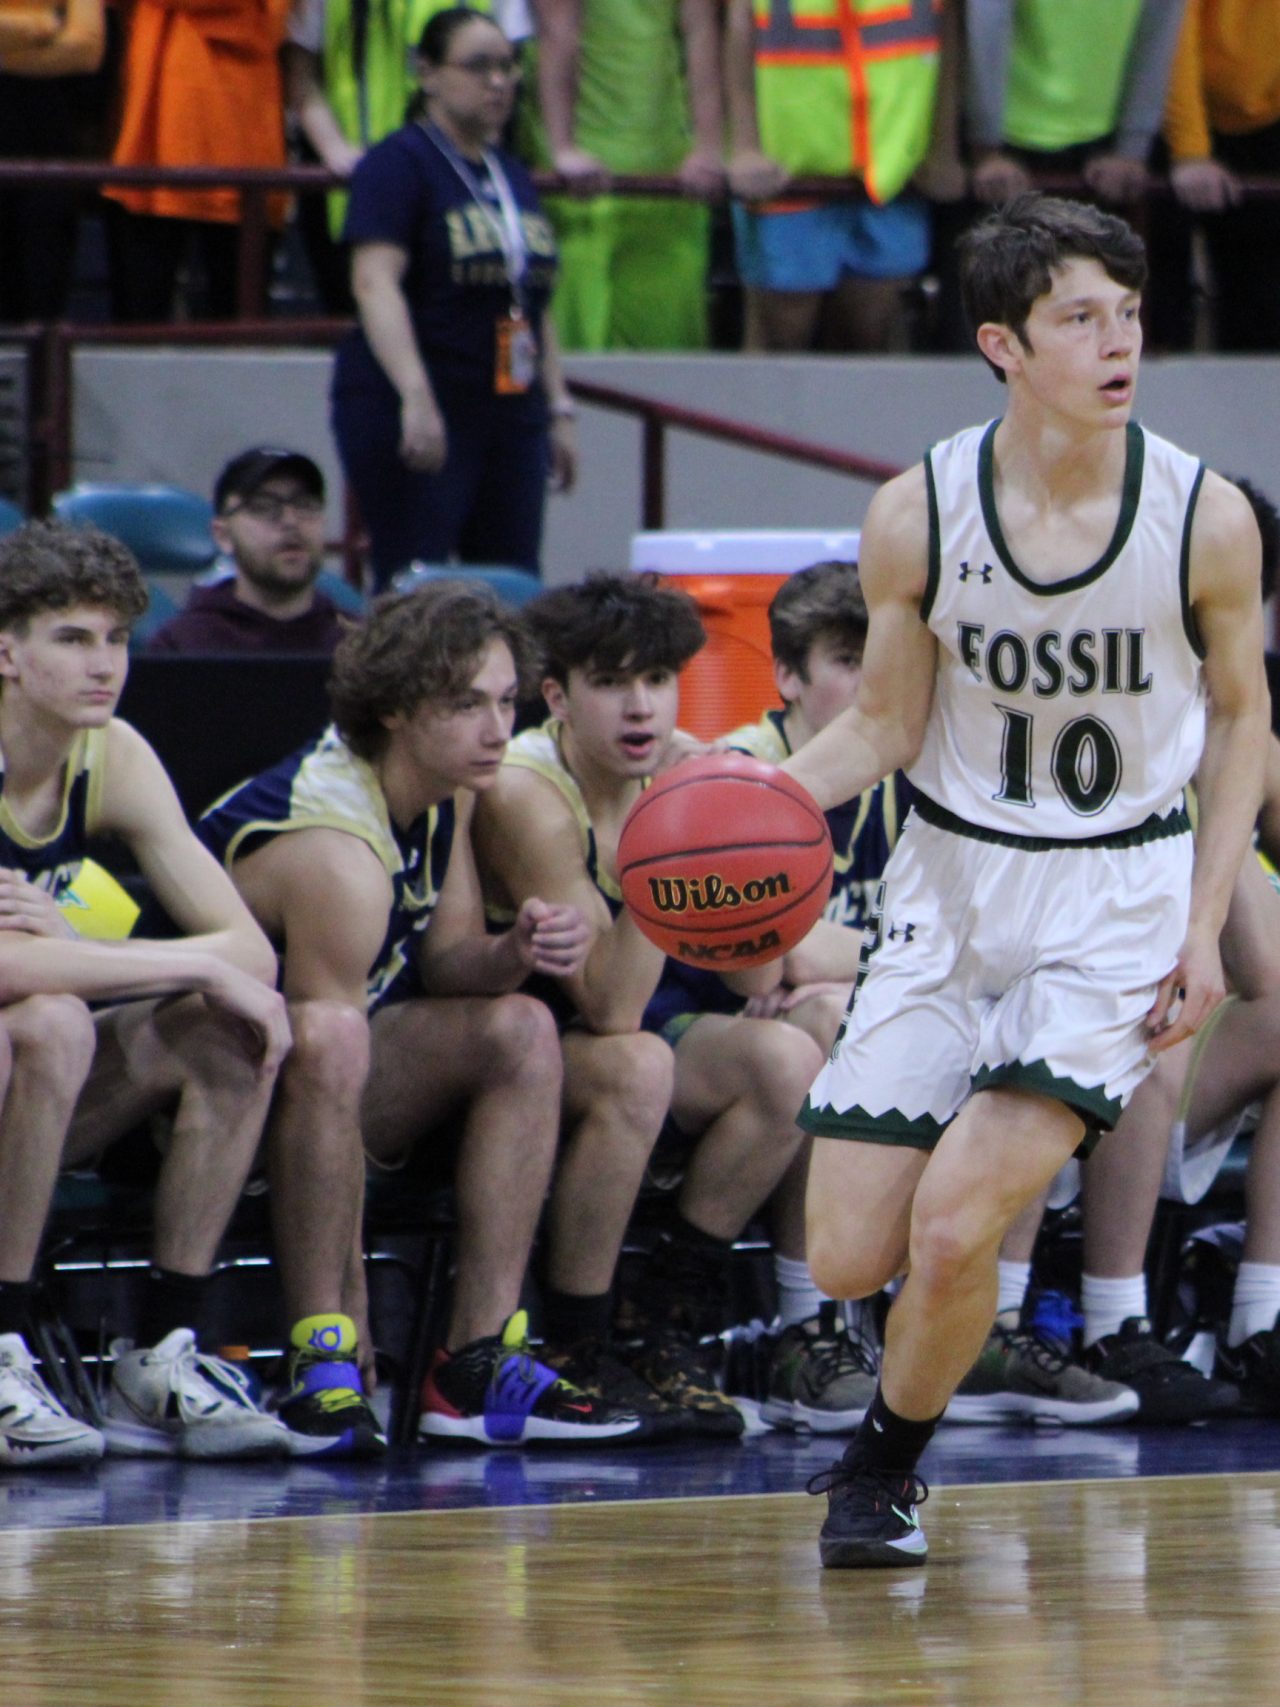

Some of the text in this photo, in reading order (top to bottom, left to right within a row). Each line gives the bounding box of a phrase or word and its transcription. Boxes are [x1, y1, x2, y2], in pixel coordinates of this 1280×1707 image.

[956, 620, 1154, 700] FOSSIL
[991, 701, 1123, 818] 10
[647, 870, 793, 914] Wilson
[677, 927, 783, 961] NCAA
